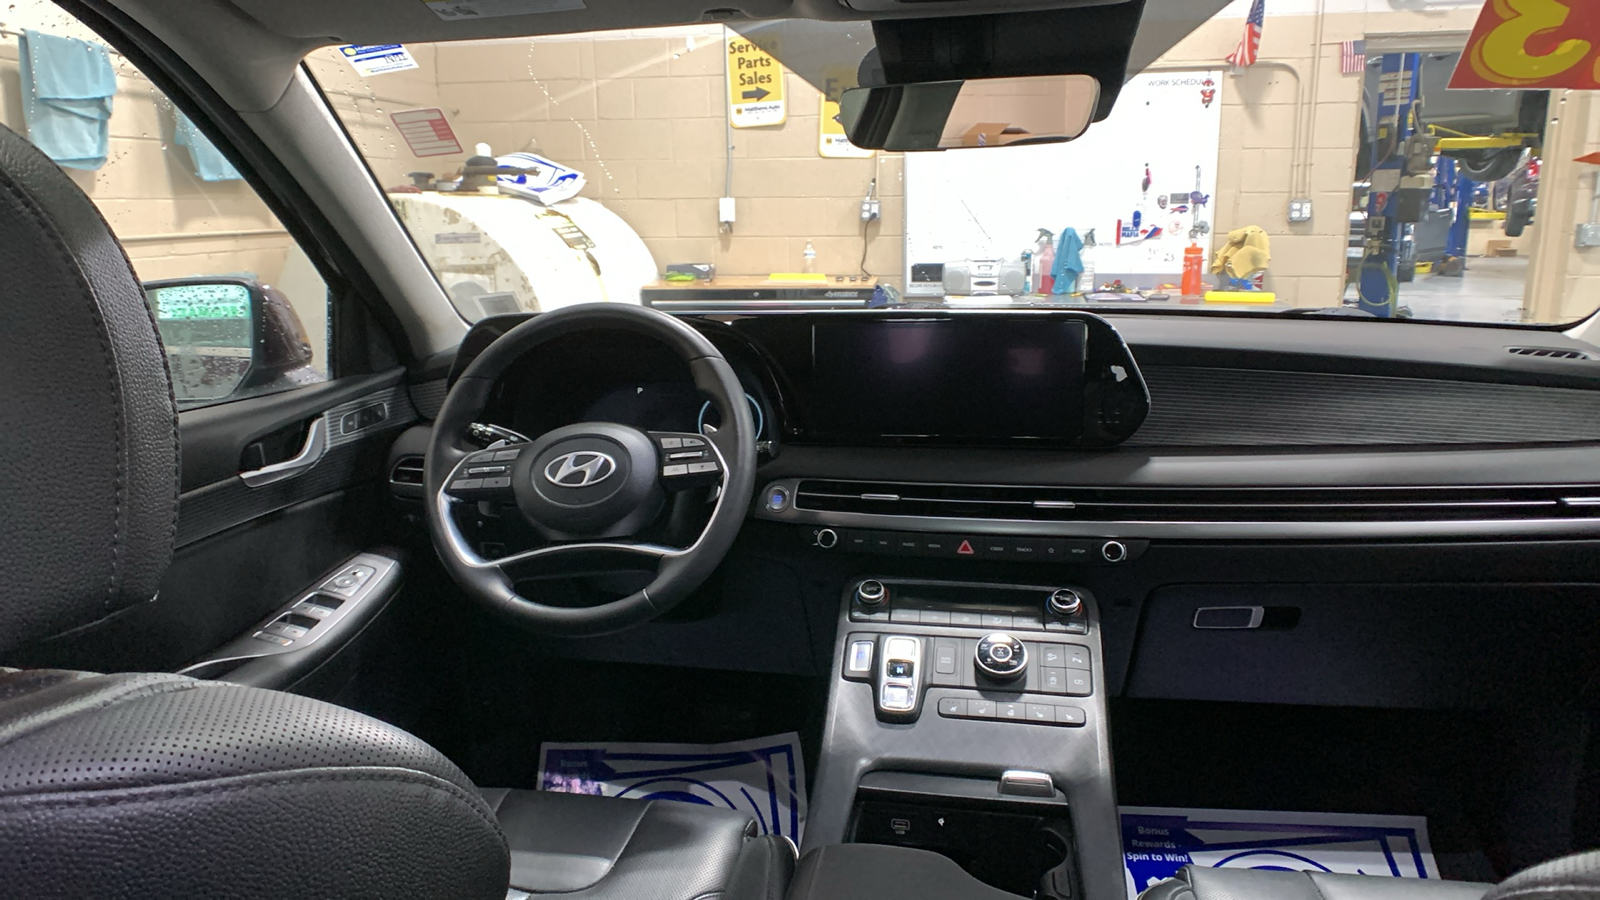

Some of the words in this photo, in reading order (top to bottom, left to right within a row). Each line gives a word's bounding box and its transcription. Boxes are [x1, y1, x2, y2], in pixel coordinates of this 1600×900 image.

[737, 56, 771, 70] Parts
[739, 71, 772, 86] Sales
[1148, 79, 1170, 87] WORK
[1138, 826, 1169, 835] Bonus
[1131, 840, 1176, 849] Rewards
[1127, 852, 1149, 862] Spin
[1151, 853, 1163, 861] to
[1164, 853, 1189, 862] Win!
